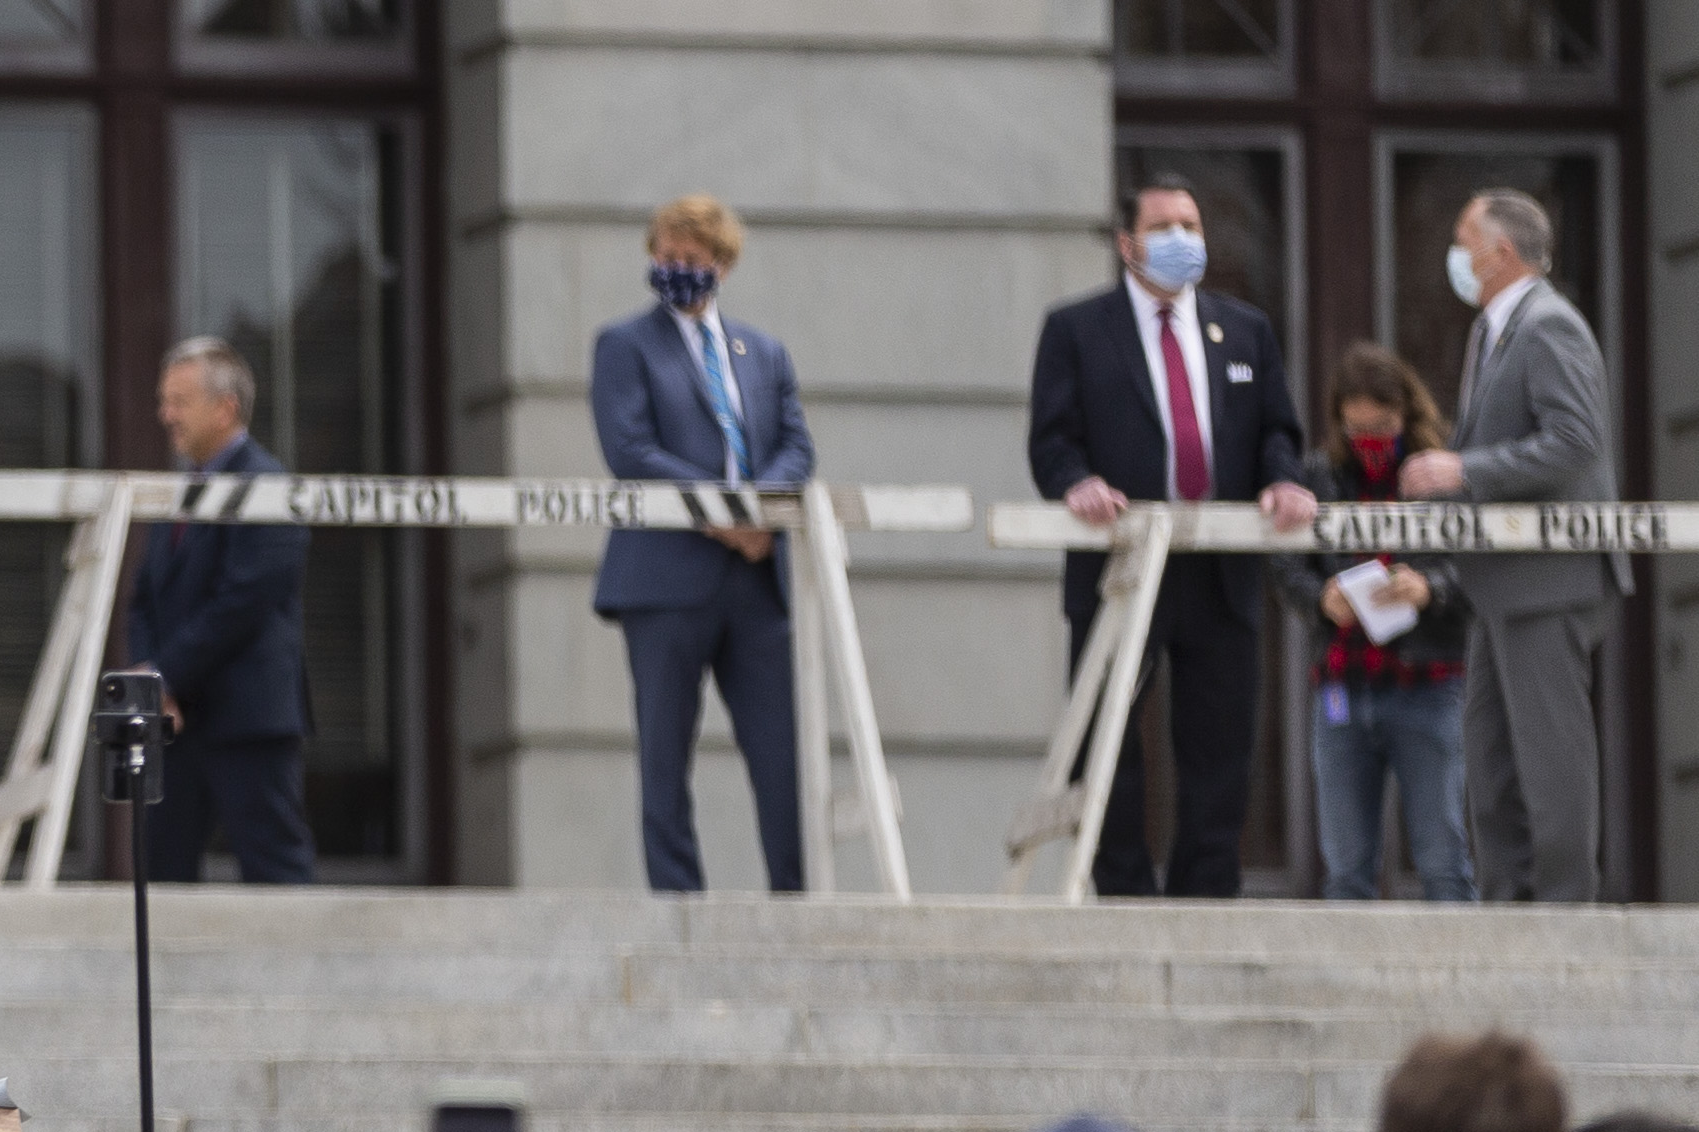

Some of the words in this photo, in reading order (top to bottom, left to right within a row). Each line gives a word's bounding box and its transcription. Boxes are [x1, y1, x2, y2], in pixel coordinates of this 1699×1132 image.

[286, 476, 468, 528] CAPITOL
[513, 482, 647, 531] POLICE
[1309, 502, 1493, 551] CAPITOL
[1538, 502, 1671, 551] POLICE
